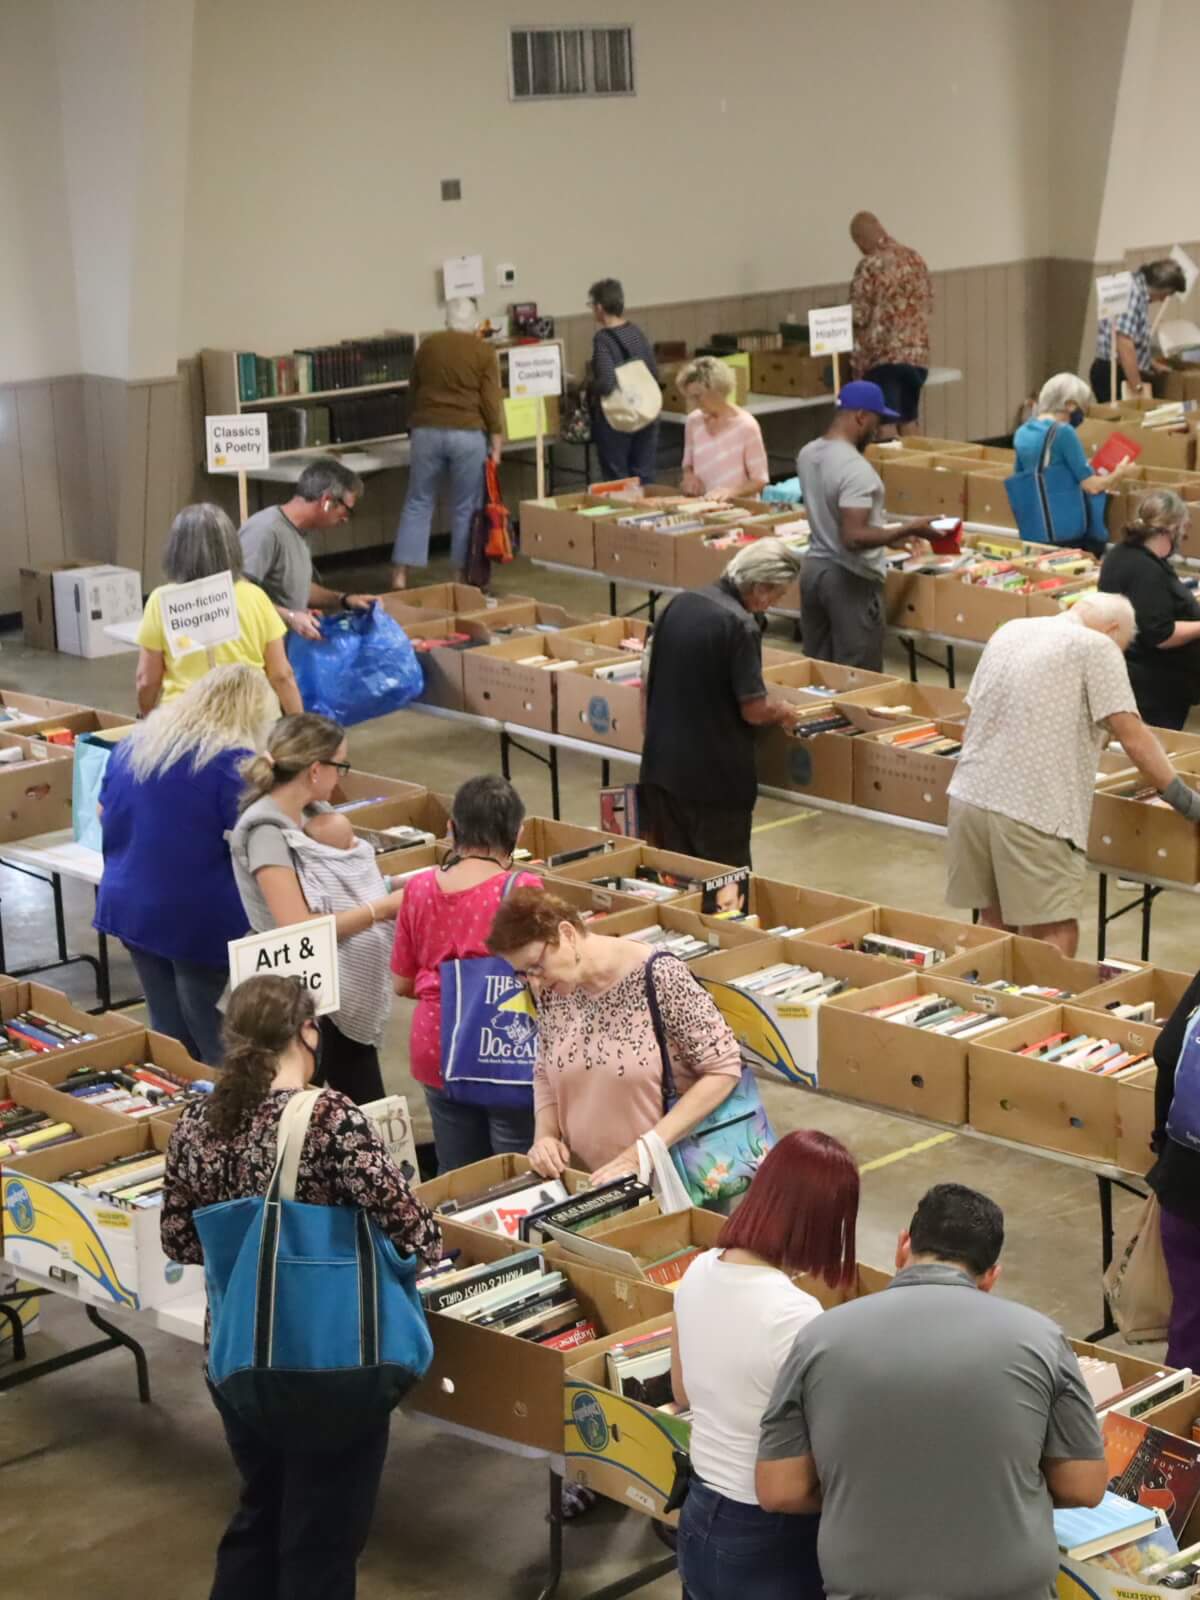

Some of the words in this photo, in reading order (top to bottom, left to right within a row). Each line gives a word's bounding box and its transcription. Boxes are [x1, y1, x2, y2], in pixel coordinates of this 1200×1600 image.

[518, 370, 553, 380] Cooking
[214, 426, 260, 438] Classics
[214, 443, 221, 453] &
[226, 442, 261, 454] Poetry
[169, 591, 228, 614] Non-fiction
[171, 607, 230, 630] Biography
[256, 944, 291, 972] Art
[299, 937, 314, 959] &
[479, 1027, 512, 1057] DOG
[488, 1277, 495, 1289] &
[496, 1267, 524, 1287] PIRATE
[464, 1281, 489, 1298] GYPSY
[438, 1292, 463, 1308] GIRLS
